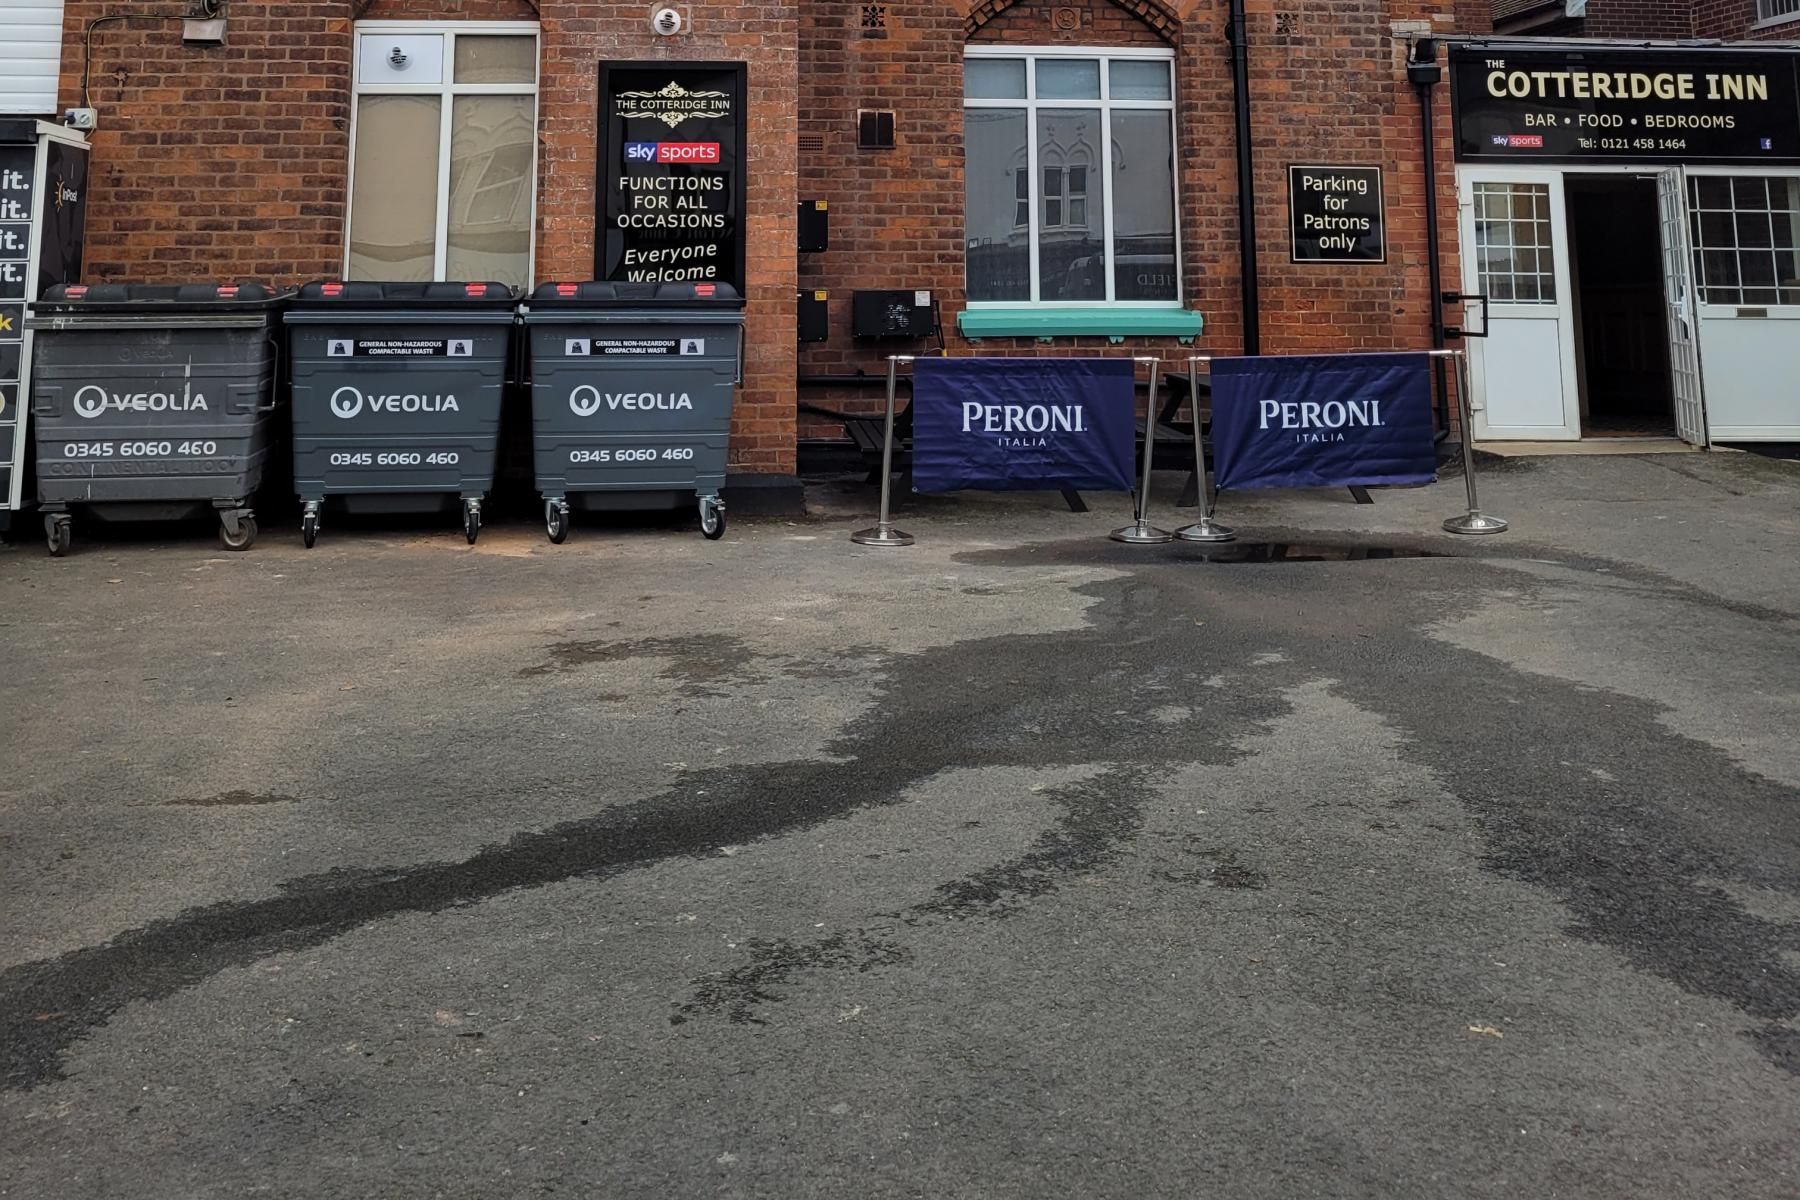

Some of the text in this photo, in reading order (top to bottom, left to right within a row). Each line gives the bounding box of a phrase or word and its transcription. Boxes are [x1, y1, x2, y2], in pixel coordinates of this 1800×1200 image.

[1486, 59, 1505, 69] THE
[1487, 71, 1768, 100] COTTERIDGE INN
[616, 100, 730, 110] THE COTTERIDGE INN
[1525, 113, 1735, 128] BAR FOOD BEDROOMS
[1493, 135, 1541, 146] sky sports
[1578, 138, 1686, 149] Tel: 0121 458 1464
[628, 143, 716, 160] sky sports
[3, 169, 29, 190] it.
[619, 177, 724, 190] FUNCTIONS
[1303, 175, 1367, 195] Parking
[62, 188, 77, 202] InPost
[634, 195, 708, 209] FOR ALL
[1323, 194, 1349, 210] for
[1, 198, 28, 218] it.
[617, 214, 725, 228] OCCASIONS
[1303, 214, 1370, 229] Patrons
[1320, 233, 1356, 252] only
[624, 243, 717, 265] Everyone
[627, 265, 716, 283] Welcome
[113, 393, 208, 411] VEOLIA
[367, 394, 460, 412] VEOLIA
[605, 393, 693, 410] VEOLIA
[998, 438, 1047, 447] ITALIA
[1296, 433, 1345, 443] ITALIA
[64, 441, 216, 457] 0345 6060 460
[569, 448, 693, 462] 0345 6060 460
[330, 453, 459, 465] 0345 6060 460
